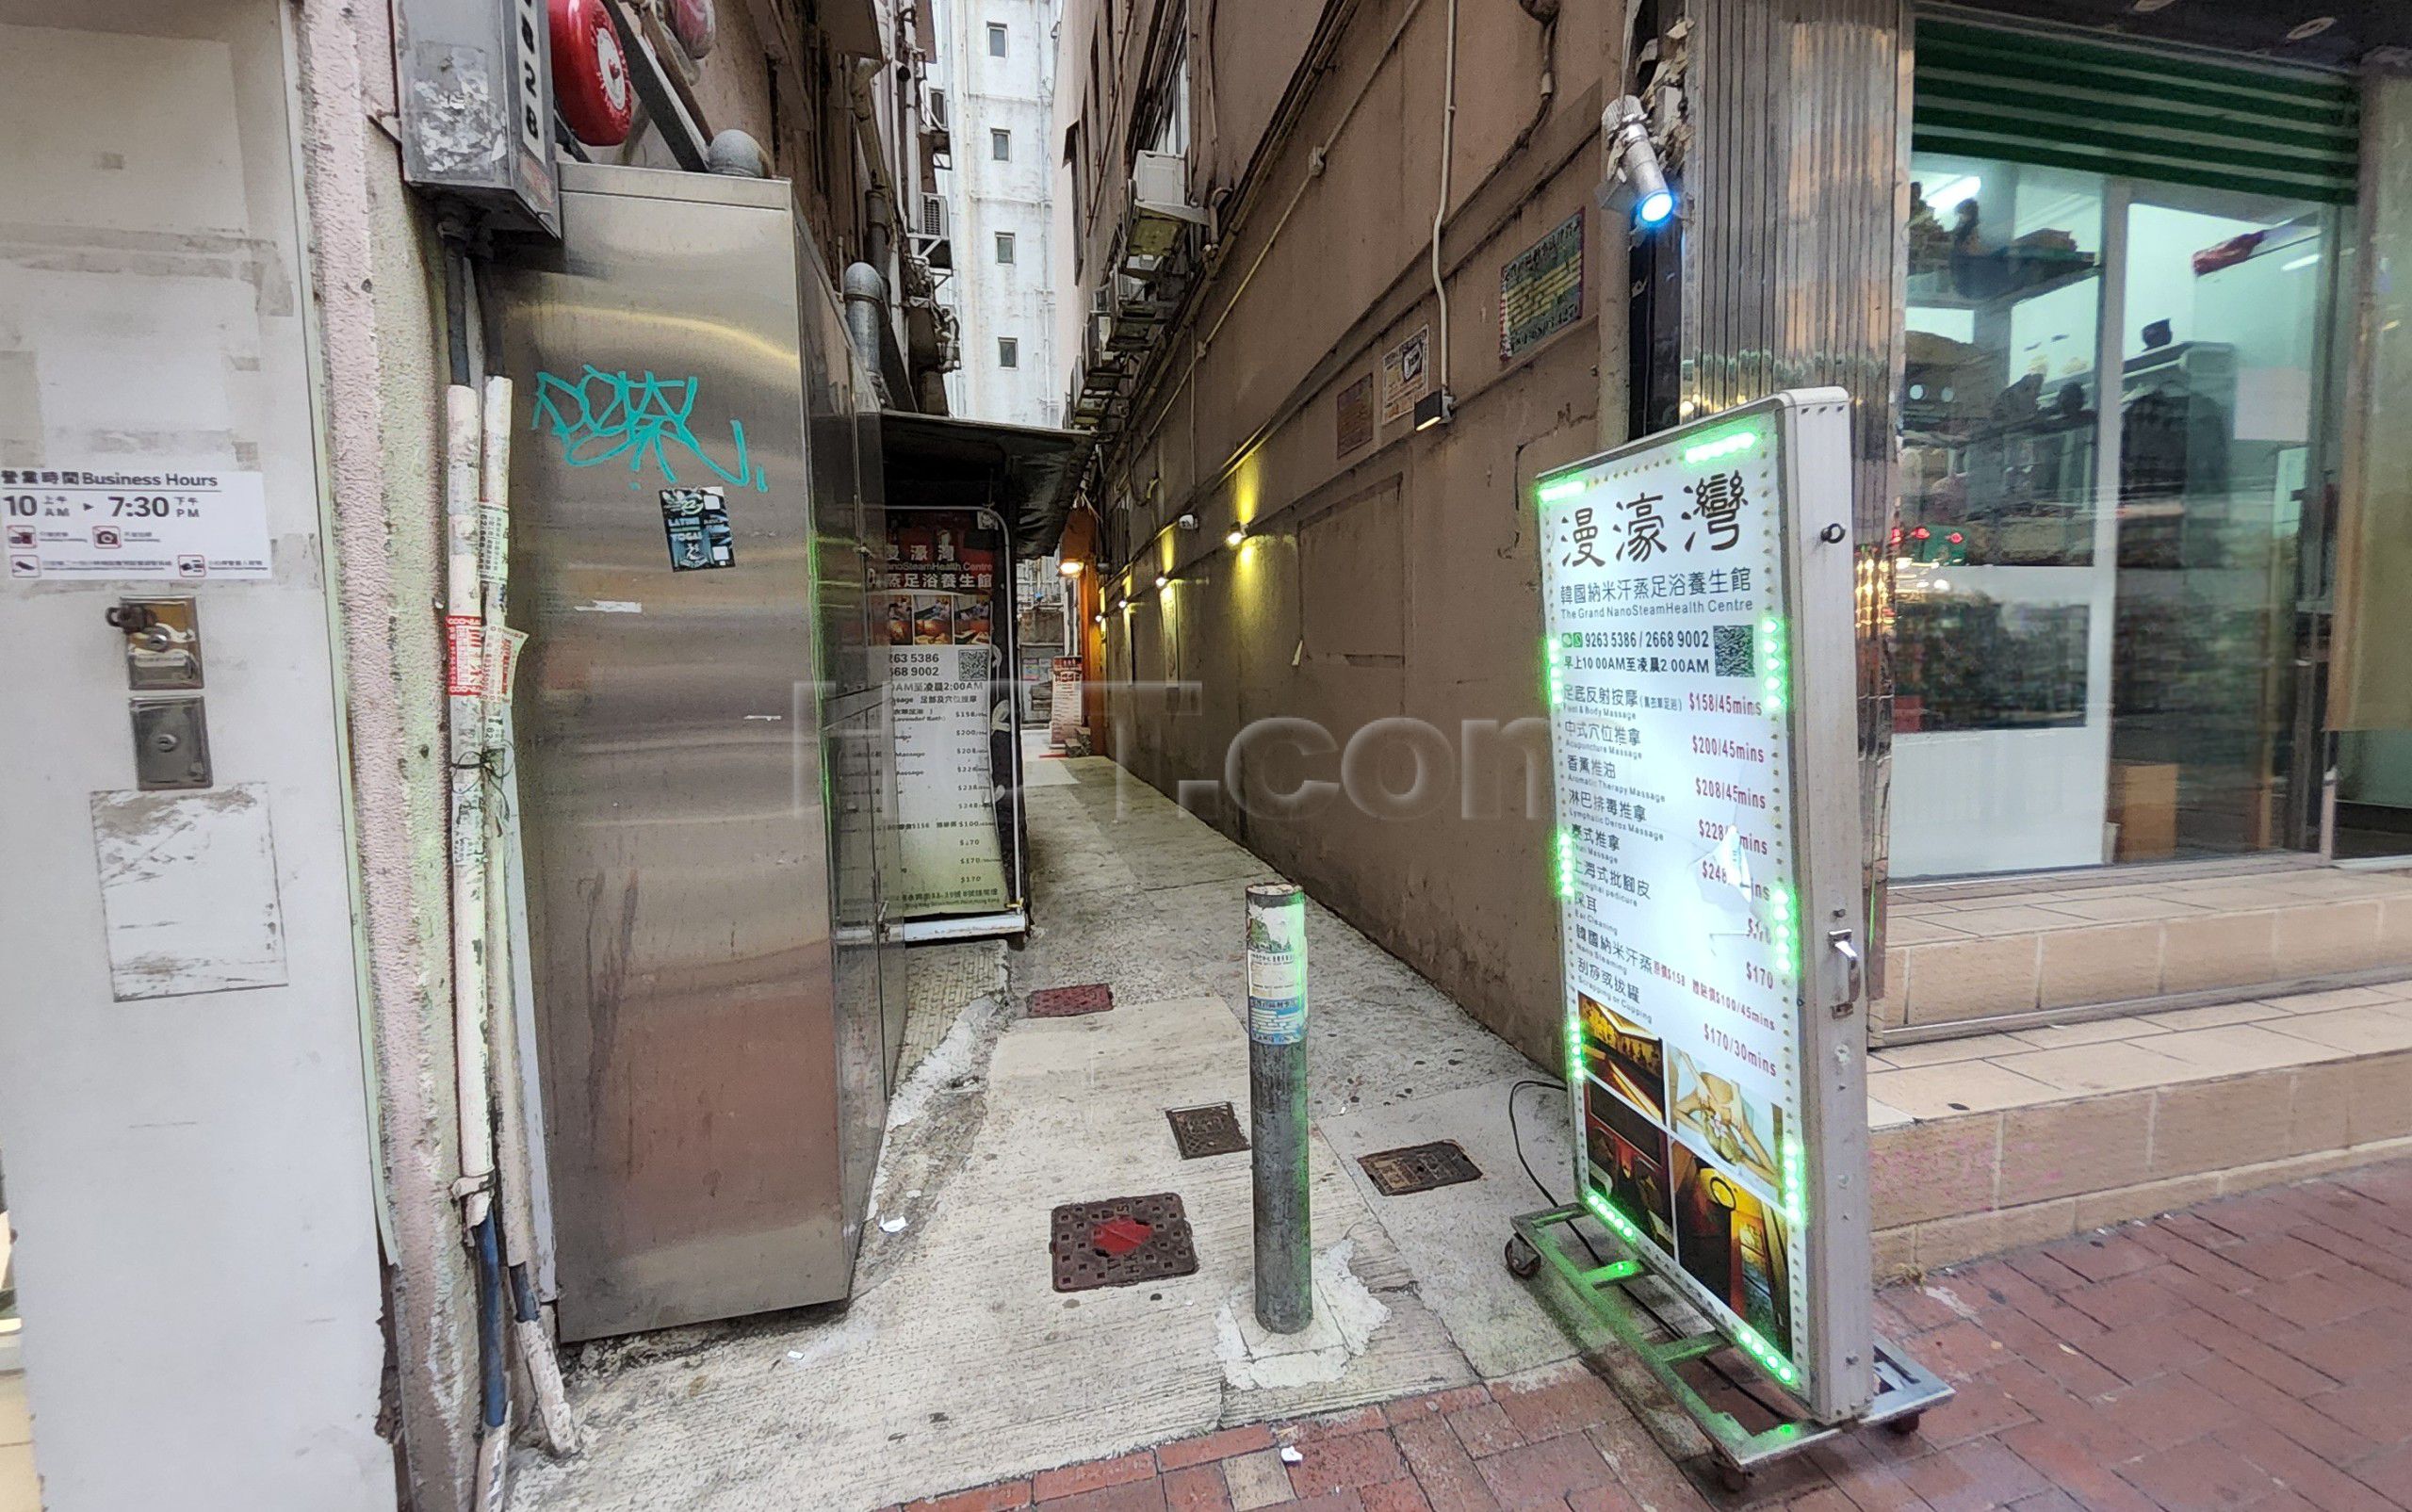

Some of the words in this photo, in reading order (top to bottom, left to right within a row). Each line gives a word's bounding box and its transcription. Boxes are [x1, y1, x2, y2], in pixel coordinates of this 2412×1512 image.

[82, 472, 161, 485] Business
[166, 473, 218, 487] Hours
[3, 496, 37, 516] 10
[44, 507, 70, 516] AM
[107, 496, 170, 517] 7:30
[176, 508, 200, 517] PM
[1560, 469, 1749, 567] 漫濠灣
[1560, 567, 1752, 606] 韓國納米汗蒸足浴養生館
[1560, 609, 1577, 620] The
[1578, 607, 1605, 619] Grand
[1707, 598, 1753, 613] Centre
[1585, 632, 1608, 648] 9263
[1610, 632, 1637, 648] 5386
[1645, 630, 1674, 648] 2668
[1677, 629, 1709, 648] 9002
[910, 654, 939, 663] 5386
[1564, 655, 1709, 673] 早上1000AM至凌晨200AM
[910, 667, 939, 676] 9002
[1688, 691, 1763, 716] $158/45mins
[1564, 721, 1640, 745] 中式穴位推拿
[1692, 735, 1765, 763] $200/45mins
[1696, 777, 1767, 809] $208/45mins
[1746, 961, 1774, 990] $170
[1703, 1023, 1777, 1077] $170/30mins
